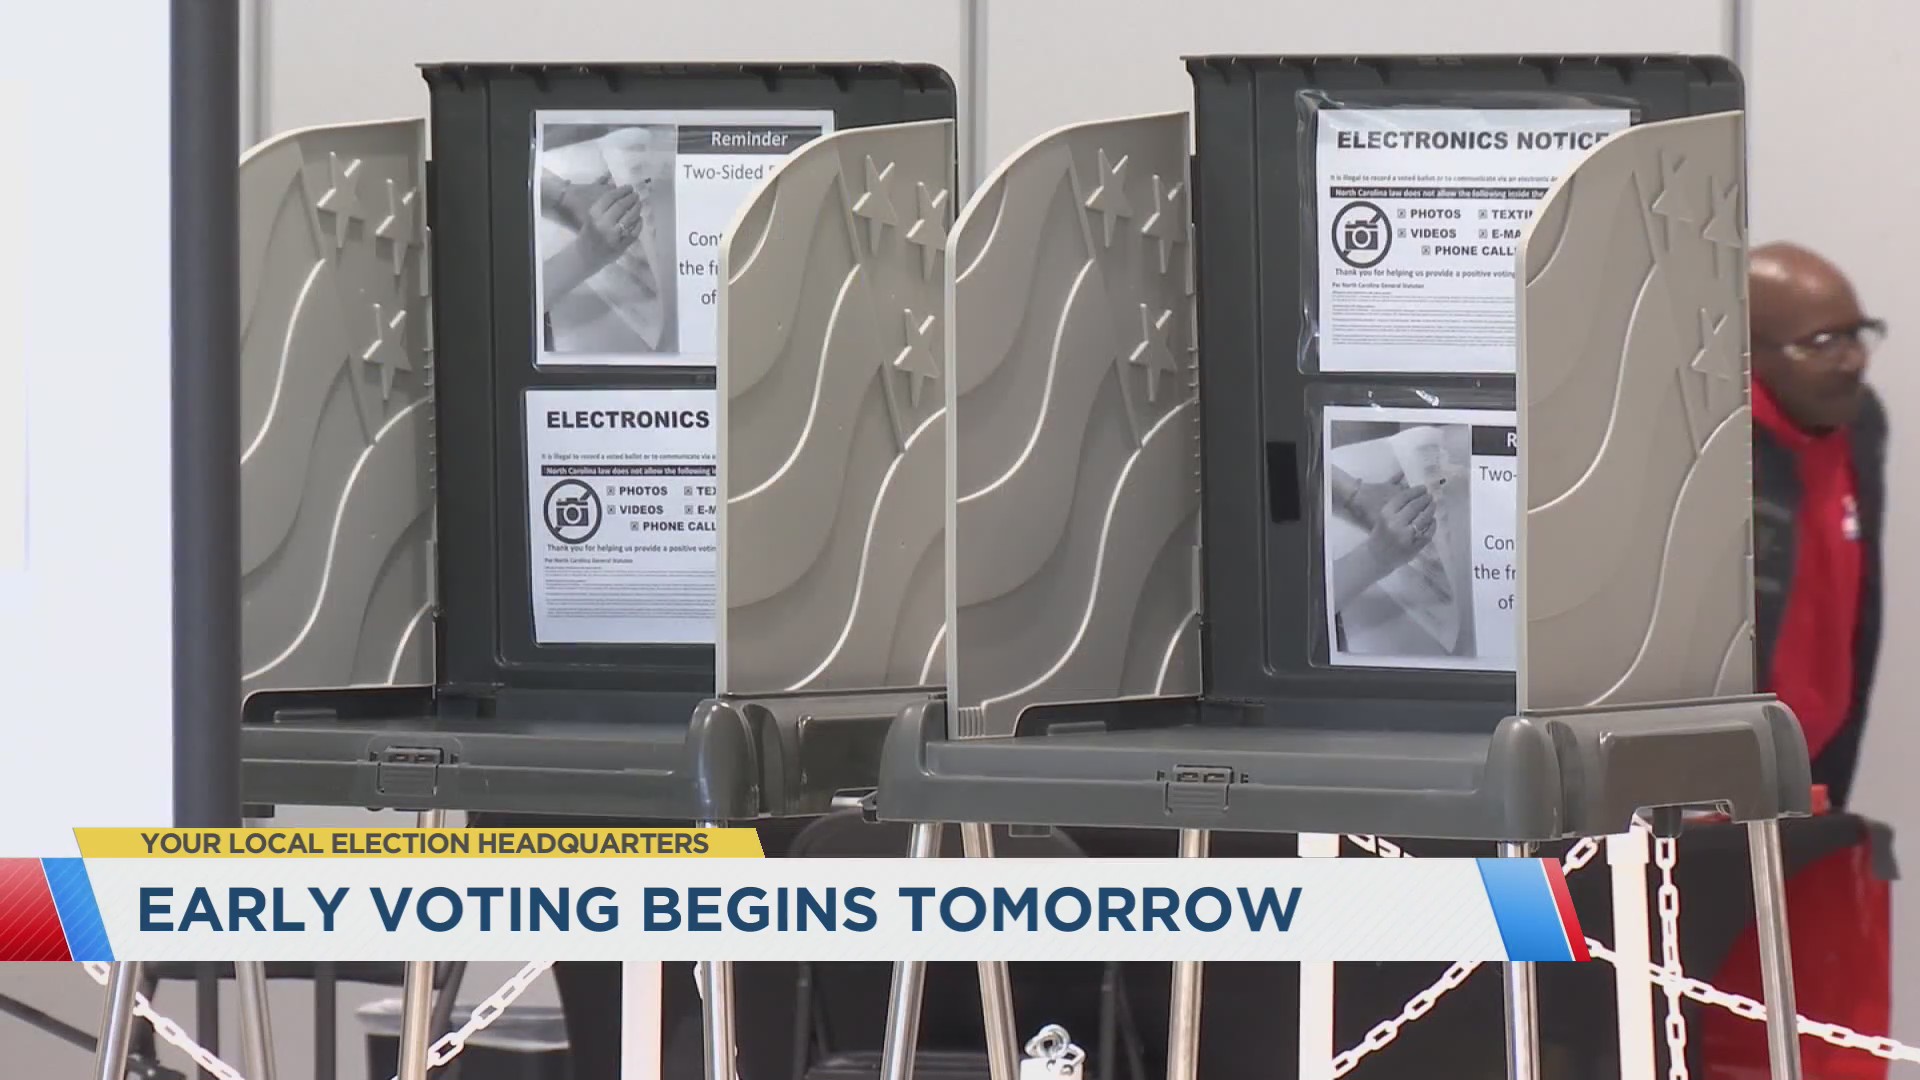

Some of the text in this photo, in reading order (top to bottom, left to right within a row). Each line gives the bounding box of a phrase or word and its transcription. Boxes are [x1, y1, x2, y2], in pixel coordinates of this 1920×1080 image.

[711, 131, 789, 147] Reminder
[1337, 131, 1508, 150] ELECTRONICS
[683, 164, 763, 180] Two-Sided
[1335, 188, 1544, 198] North Carolina law does not allow the following inside the
[1410, 208, 1461, 219] PHOTOS
[1411, 228, 1457, 239] VIDEOS
[1435, 246, 1516, 256] PHONE CALL
[679, 260, 704, 276] the
[1335, 268, 1356, 279] Thank
[1359, 268, 1373, 279] you
[1374, 268, 1385, 279] for
[1386, 268, 1414, 279] helping
[1415, 268, 1424, 279] us
[1425, 268, 1453, 279] provide
[1455, 268, 1460, 279] a
[1462, 268, 1491, 279] positive
[701, 289, 717, 305] of
[547, 411, 709, 429] ELECTRONICS
[545, 466, 567, 476] North
[567, 466, 597, 476] Carolina
[598, 466, 611, 476] law
[612, 466, 629, 476] does
[630, 466, 642, 476] not
[643, 466, 663, 476] allow
[664, 466, 676, 476] the
[677, 466, 710, 476] following
[619, 486, 668, 496] PHOTOS
[620, 505, 664, 515] VIDEOS
[643, 521, 684, 531] PHONE
[547, 544, 568, 554] Thank
[570, 544, 583, 554] you
[585, 544, 595, 554] for
[597, 544, 623, 554] helping
[624, 544, 632, 554] us
[634, 544, 660, 554] provide
[663, 544, 667, 554] a
[669, 544, 697, 554] positive
[1474, 564, 1501, 580] the
[1498, 593, 1515, 610] of
